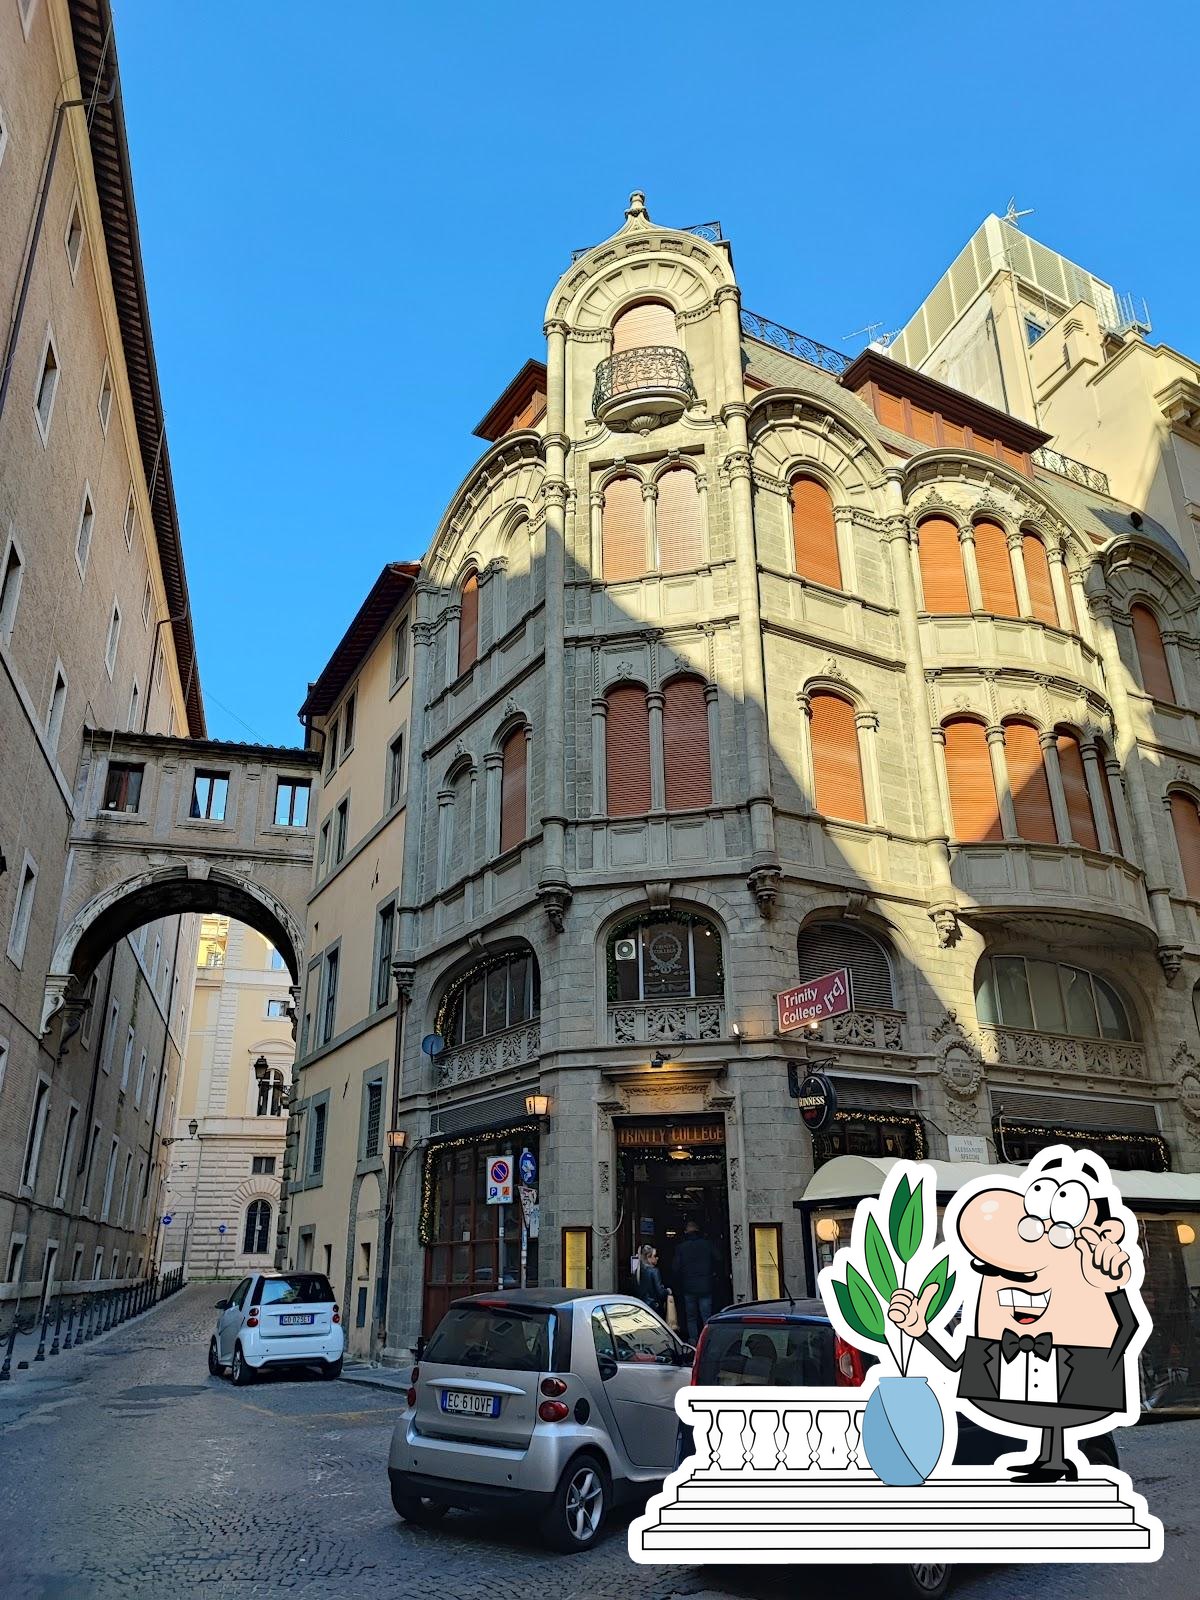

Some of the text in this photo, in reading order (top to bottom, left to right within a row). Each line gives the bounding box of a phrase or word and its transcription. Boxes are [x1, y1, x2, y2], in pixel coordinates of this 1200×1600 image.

[784, 988, 818, 1008] Trinity
[783, 1003, 823, 1025] College
[619, 1126, 724, 1144] TRINITY COLLEGE
